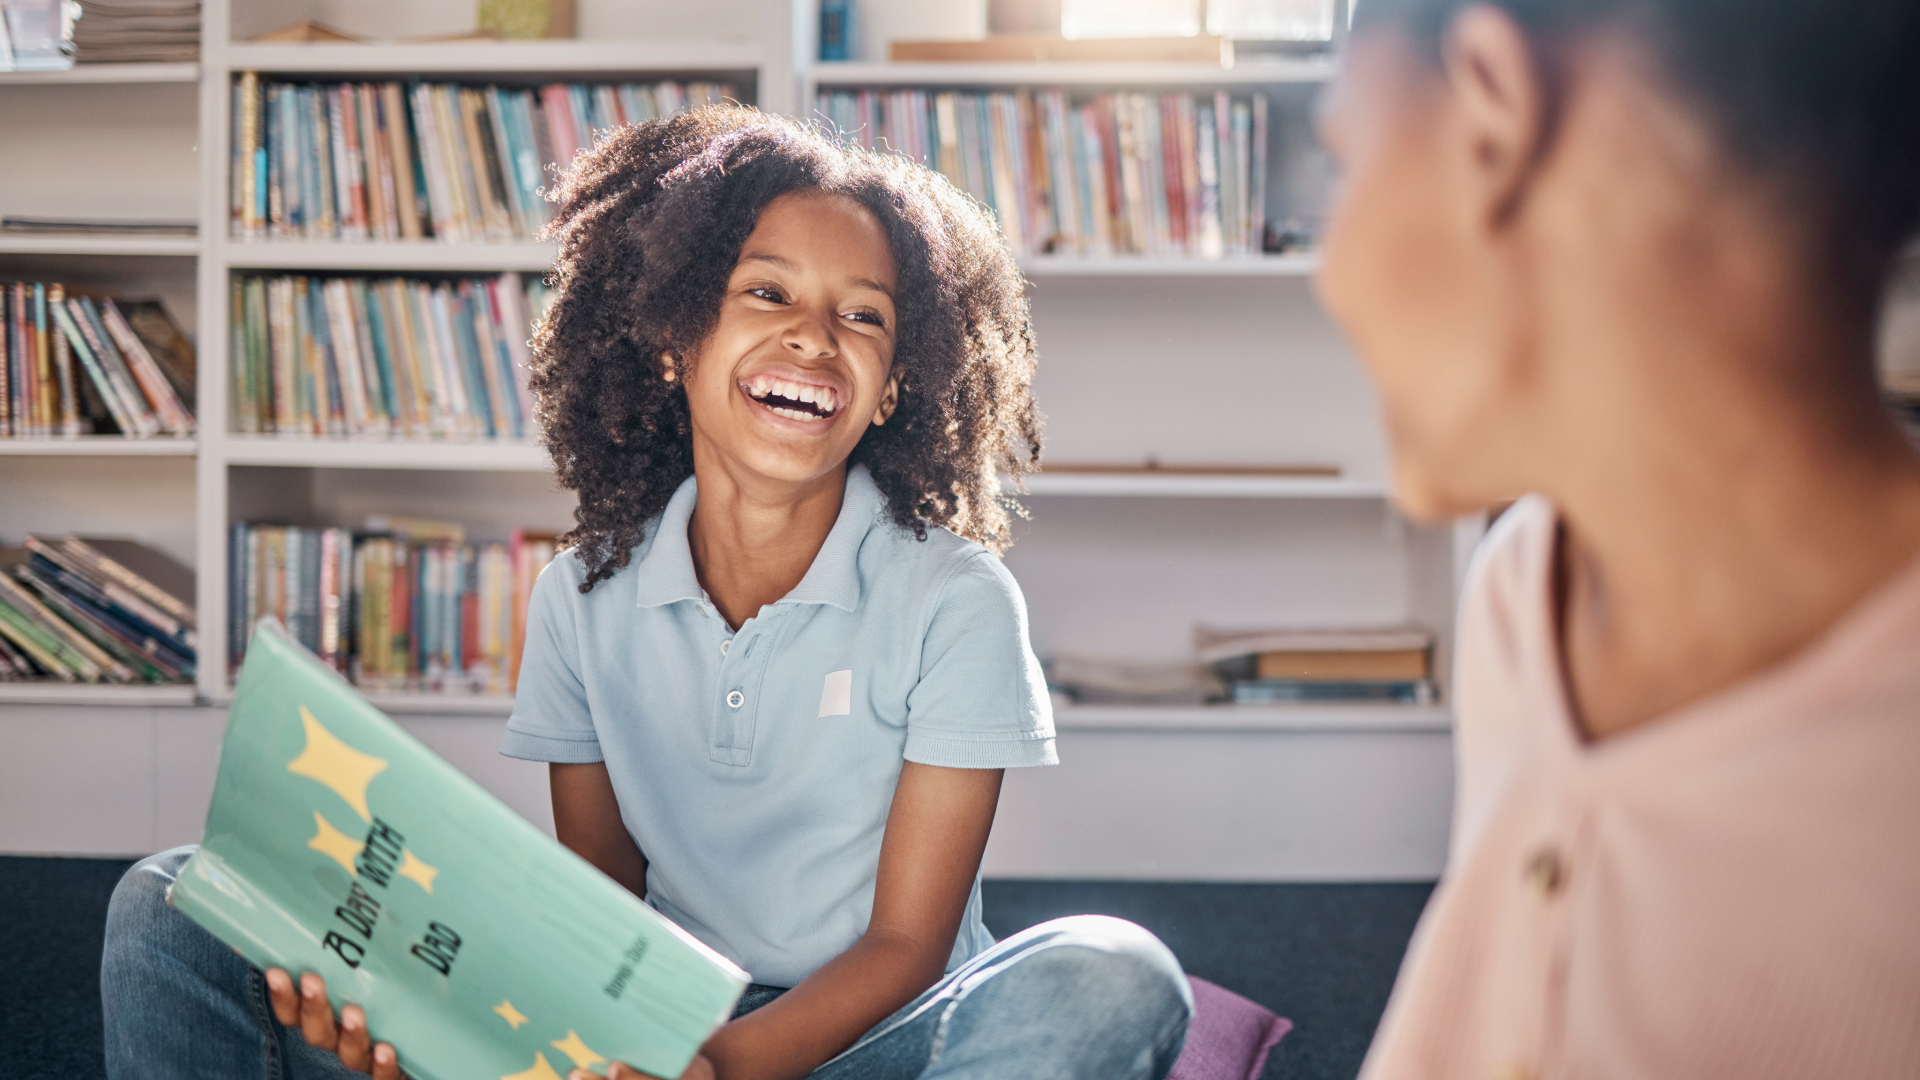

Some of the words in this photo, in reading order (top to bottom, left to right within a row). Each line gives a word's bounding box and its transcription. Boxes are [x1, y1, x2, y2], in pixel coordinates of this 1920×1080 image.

[322, 929, 366, 969] A
[356, 816, 405, 889] WITH
[410, 920, 462, 977] DAD
